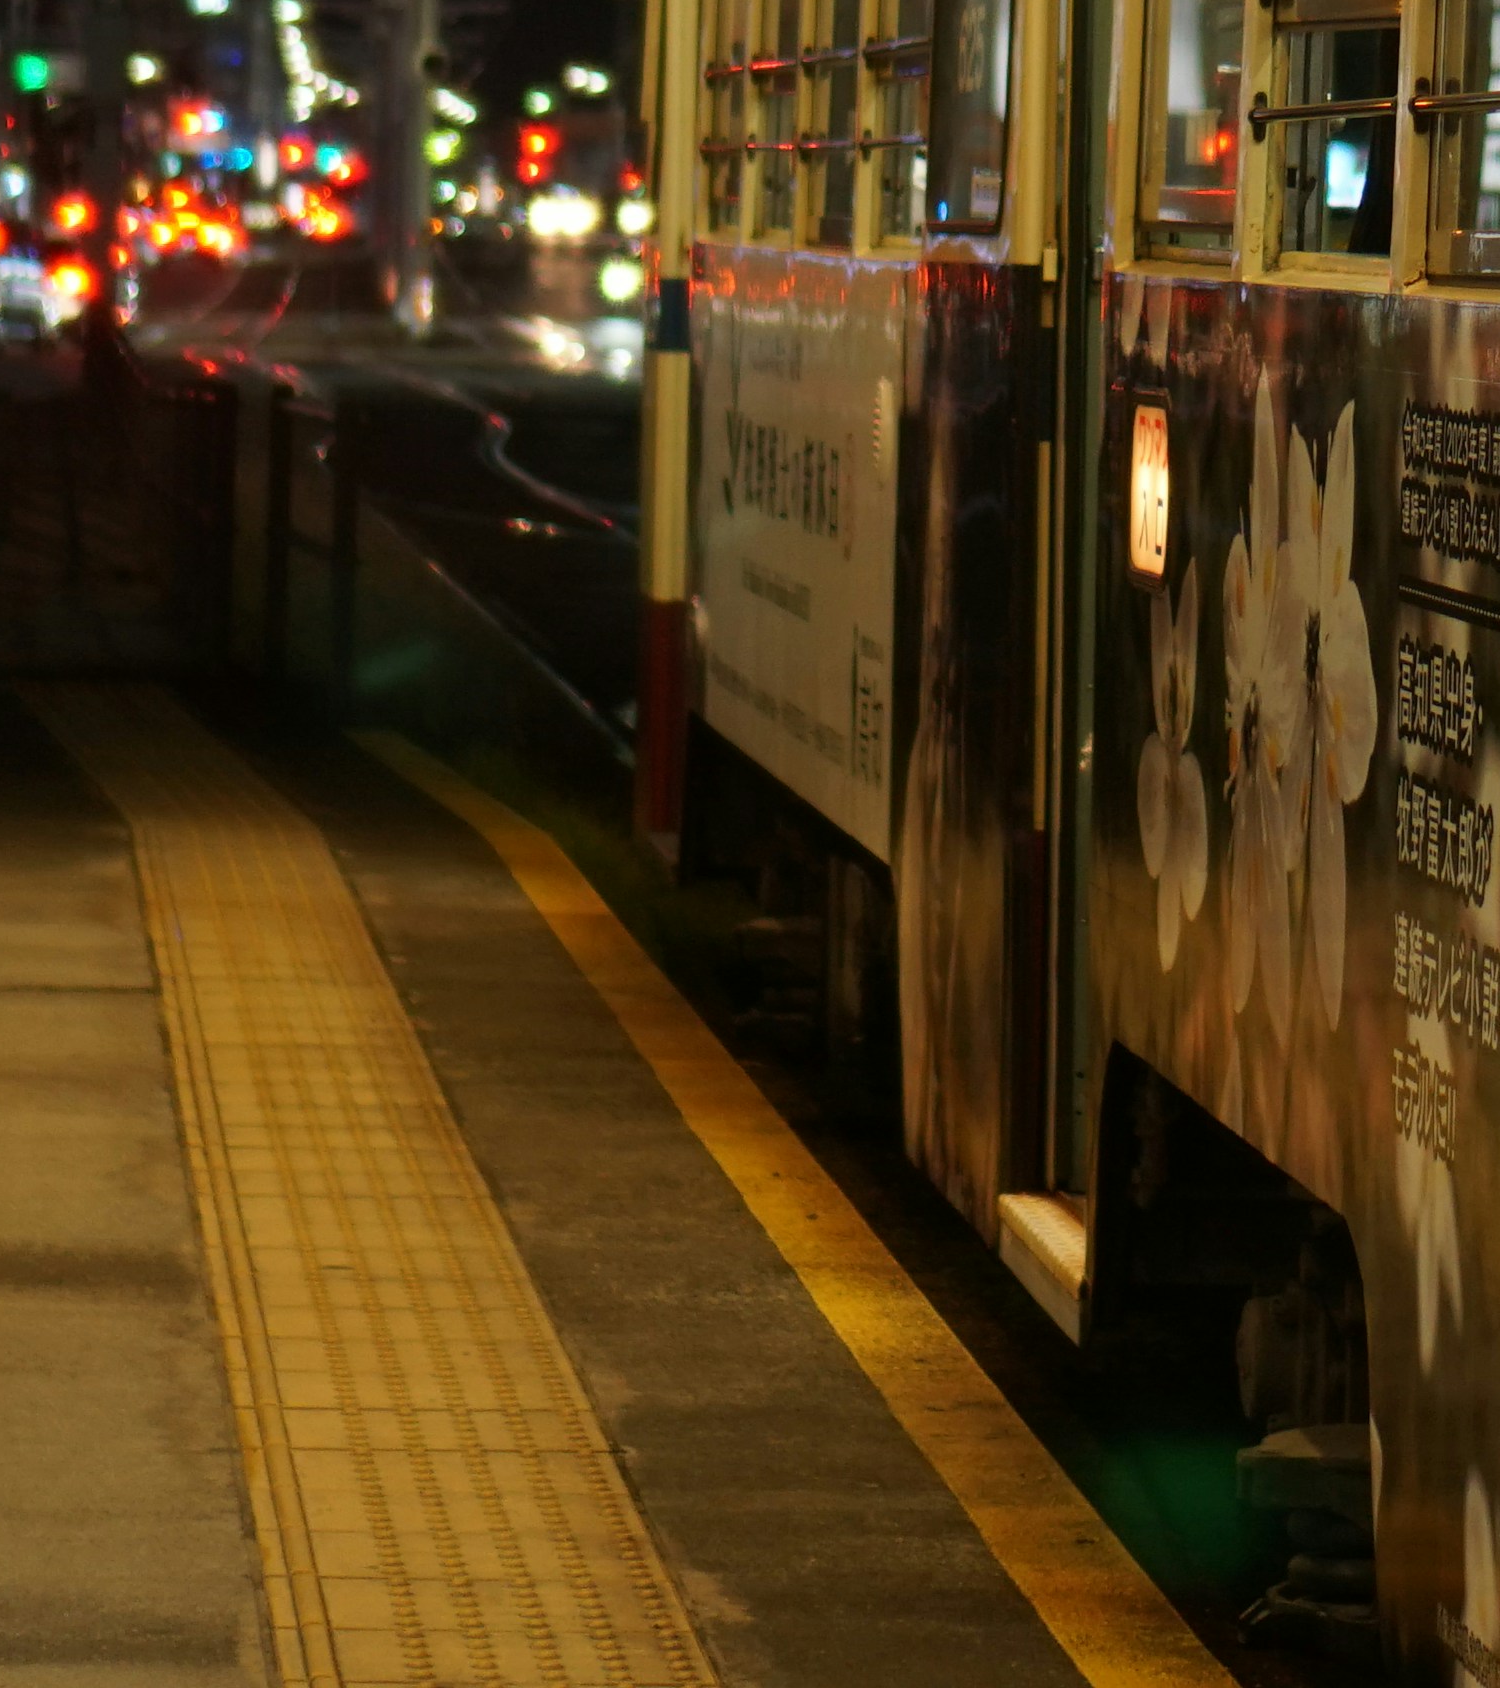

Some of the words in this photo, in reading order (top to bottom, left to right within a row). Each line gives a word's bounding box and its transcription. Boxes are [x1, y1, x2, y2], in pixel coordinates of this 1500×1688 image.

[1396, 777, 1492, 896] 牧野富太郎が
